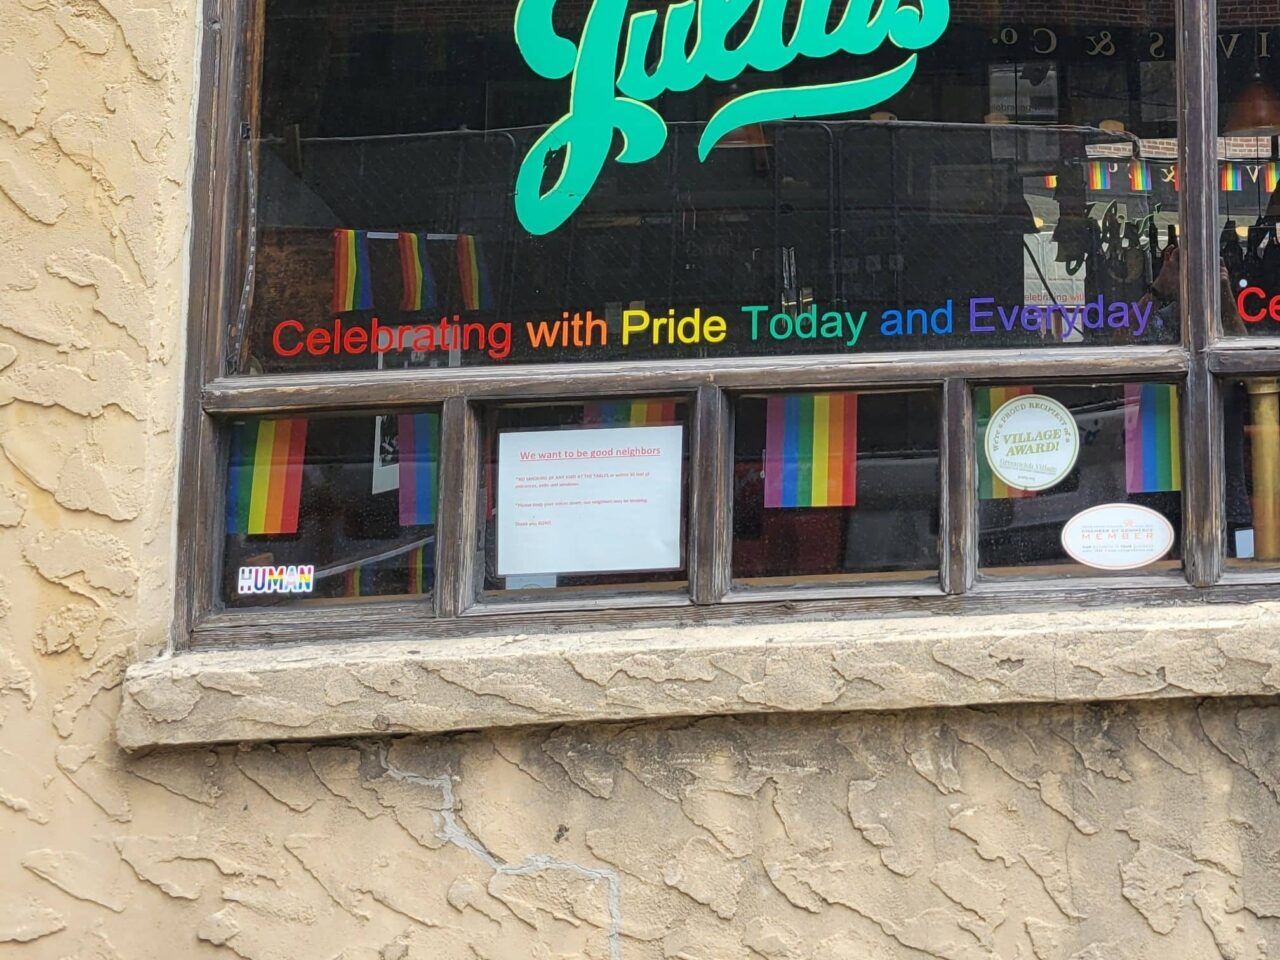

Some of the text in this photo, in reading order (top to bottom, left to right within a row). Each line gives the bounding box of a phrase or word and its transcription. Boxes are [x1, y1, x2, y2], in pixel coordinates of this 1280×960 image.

[273, 315, 512, 359] Celebrating
[527, 311, 608, 348] with
[621, 308, 727, 345] Pride
[741, 304, 867, 346] Today
[880, 299, 953, 336] and
[1003, 429, 1061, 444] VILLAGE
[520, 446, 661, 460] We want to be good neighbors
[1006, 441, 1060, 456] AWARD!
[239, 565, 314, 593] HUMAN
